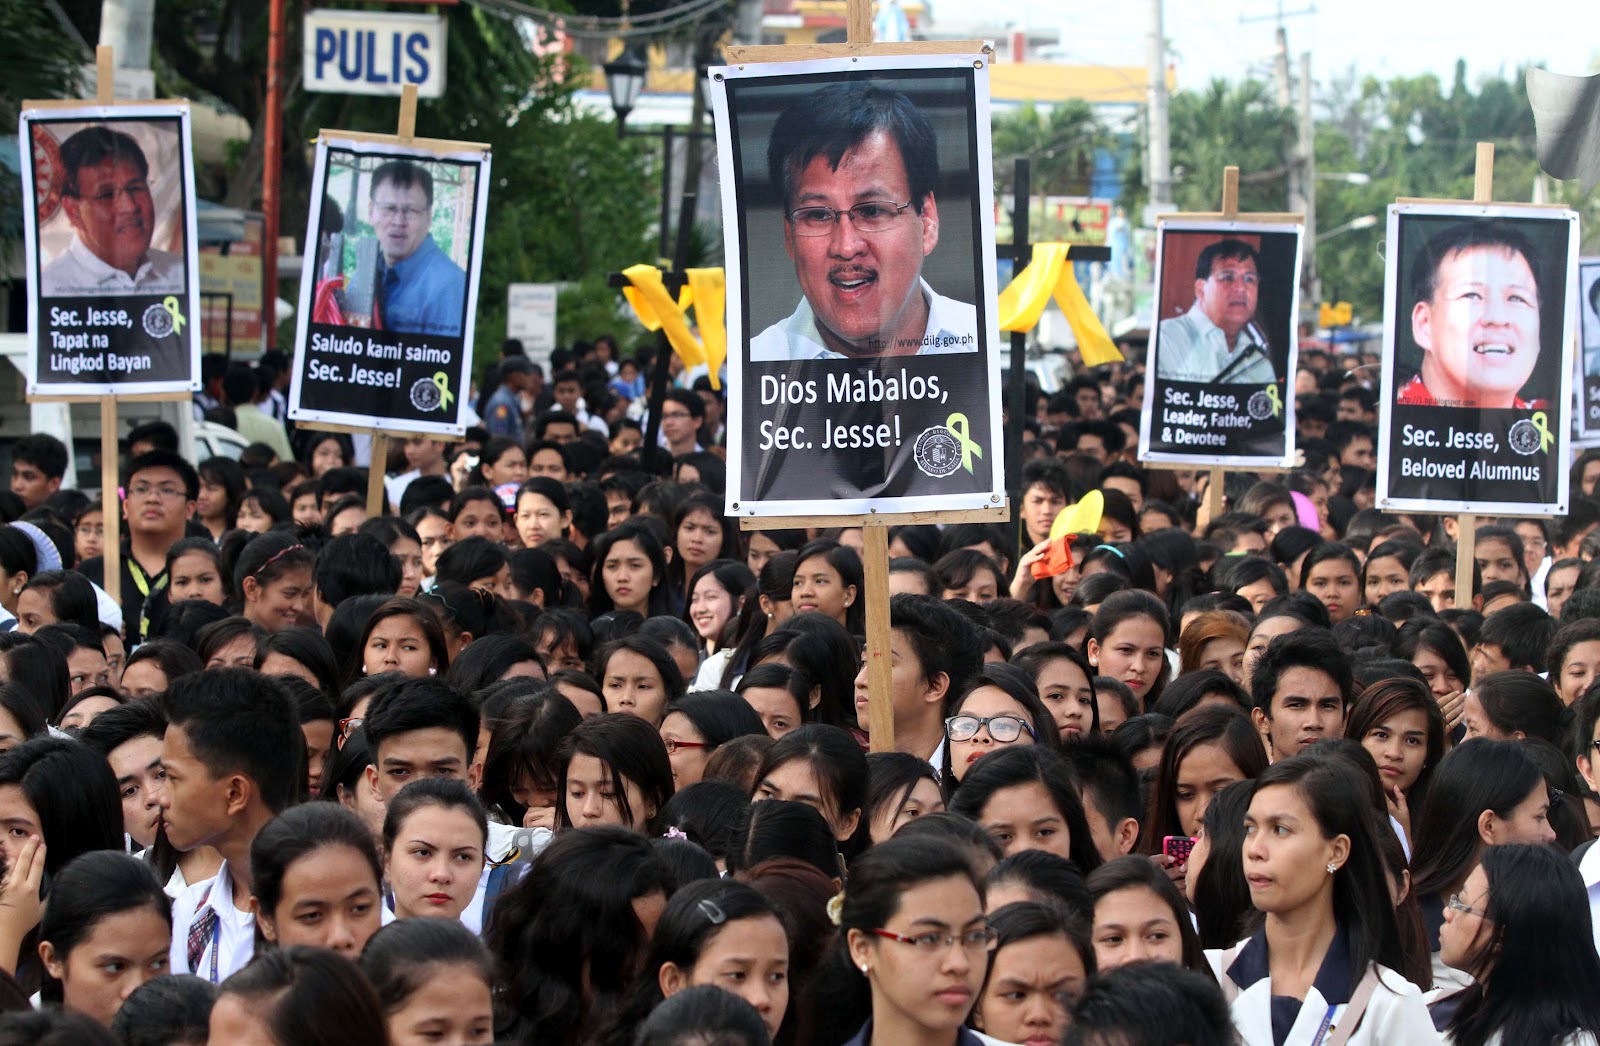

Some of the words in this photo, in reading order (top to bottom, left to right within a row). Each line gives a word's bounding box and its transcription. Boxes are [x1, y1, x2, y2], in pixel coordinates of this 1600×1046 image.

[315, 27, 430, 84] PULIS
[50, 306, 82, 327] Sec.
[86, 307, 133, 329] Jesse,
[51, 331, 89, 352] Tapat
[92, 335, 109, 349] na
[311, 332, 363, 356] Saludo
[366, 337, 402, 360] kami
[405, 344, 451, 364] saimo
[868, 333, 974, 350] http://www.dilg.gov.ph
[51, 352, 103, 375] Lingkod
[108, 353, 151, 374] Bayan
[308, 358, 344, 383] Sec.
[348, 362, 402, 389] Jesse!
[761, 374, 818, 405] Dios
[827, 368, 949, 405] Mabalos,
[1164, 387, 1193, 406] Sec.
[1197, 390, 1240, 411] Jesse,
[1163, 408, 1208, 429] Leader,
[1210, 412, 1252, 429] Father,
[759, 420, 813, 450] Sec.
[821, 415, 901, 450] Jesse!
[1161, 427, 1173, 443] &
[1175, 428, 1227, 446] Devotee
[1402, 424, 1440, 447] Sec.
[1445, 426, 1500, 453] Jesse,
[1401, 457, 1465, 479] Beloved
[1470, 460, 1540, 481] Alumnus
